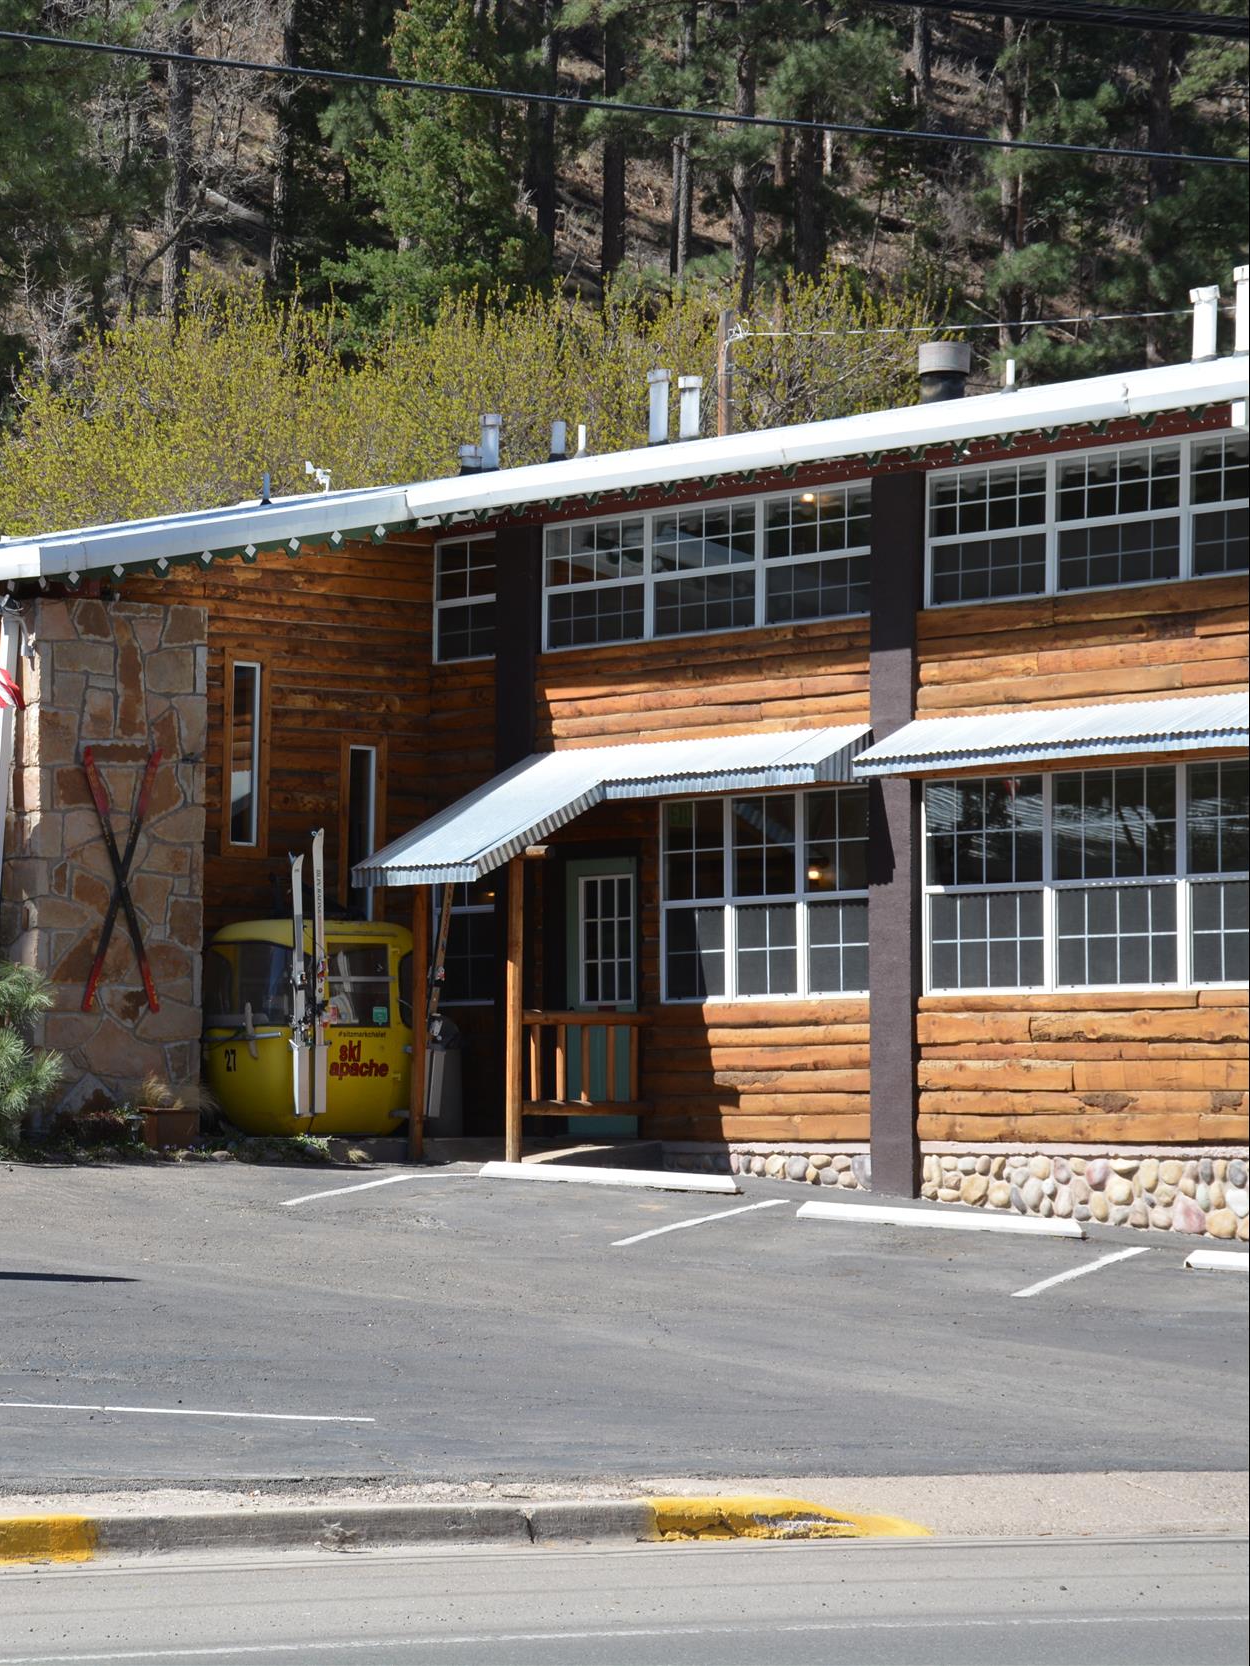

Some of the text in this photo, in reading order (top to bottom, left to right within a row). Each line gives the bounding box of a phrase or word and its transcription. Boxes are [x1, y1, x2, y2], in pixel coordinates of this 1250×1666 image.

[224, 1048, 236, 1072] 27
[339, 1040, 361, 1062] ski
[329, 1058, 389, 1080] apache
